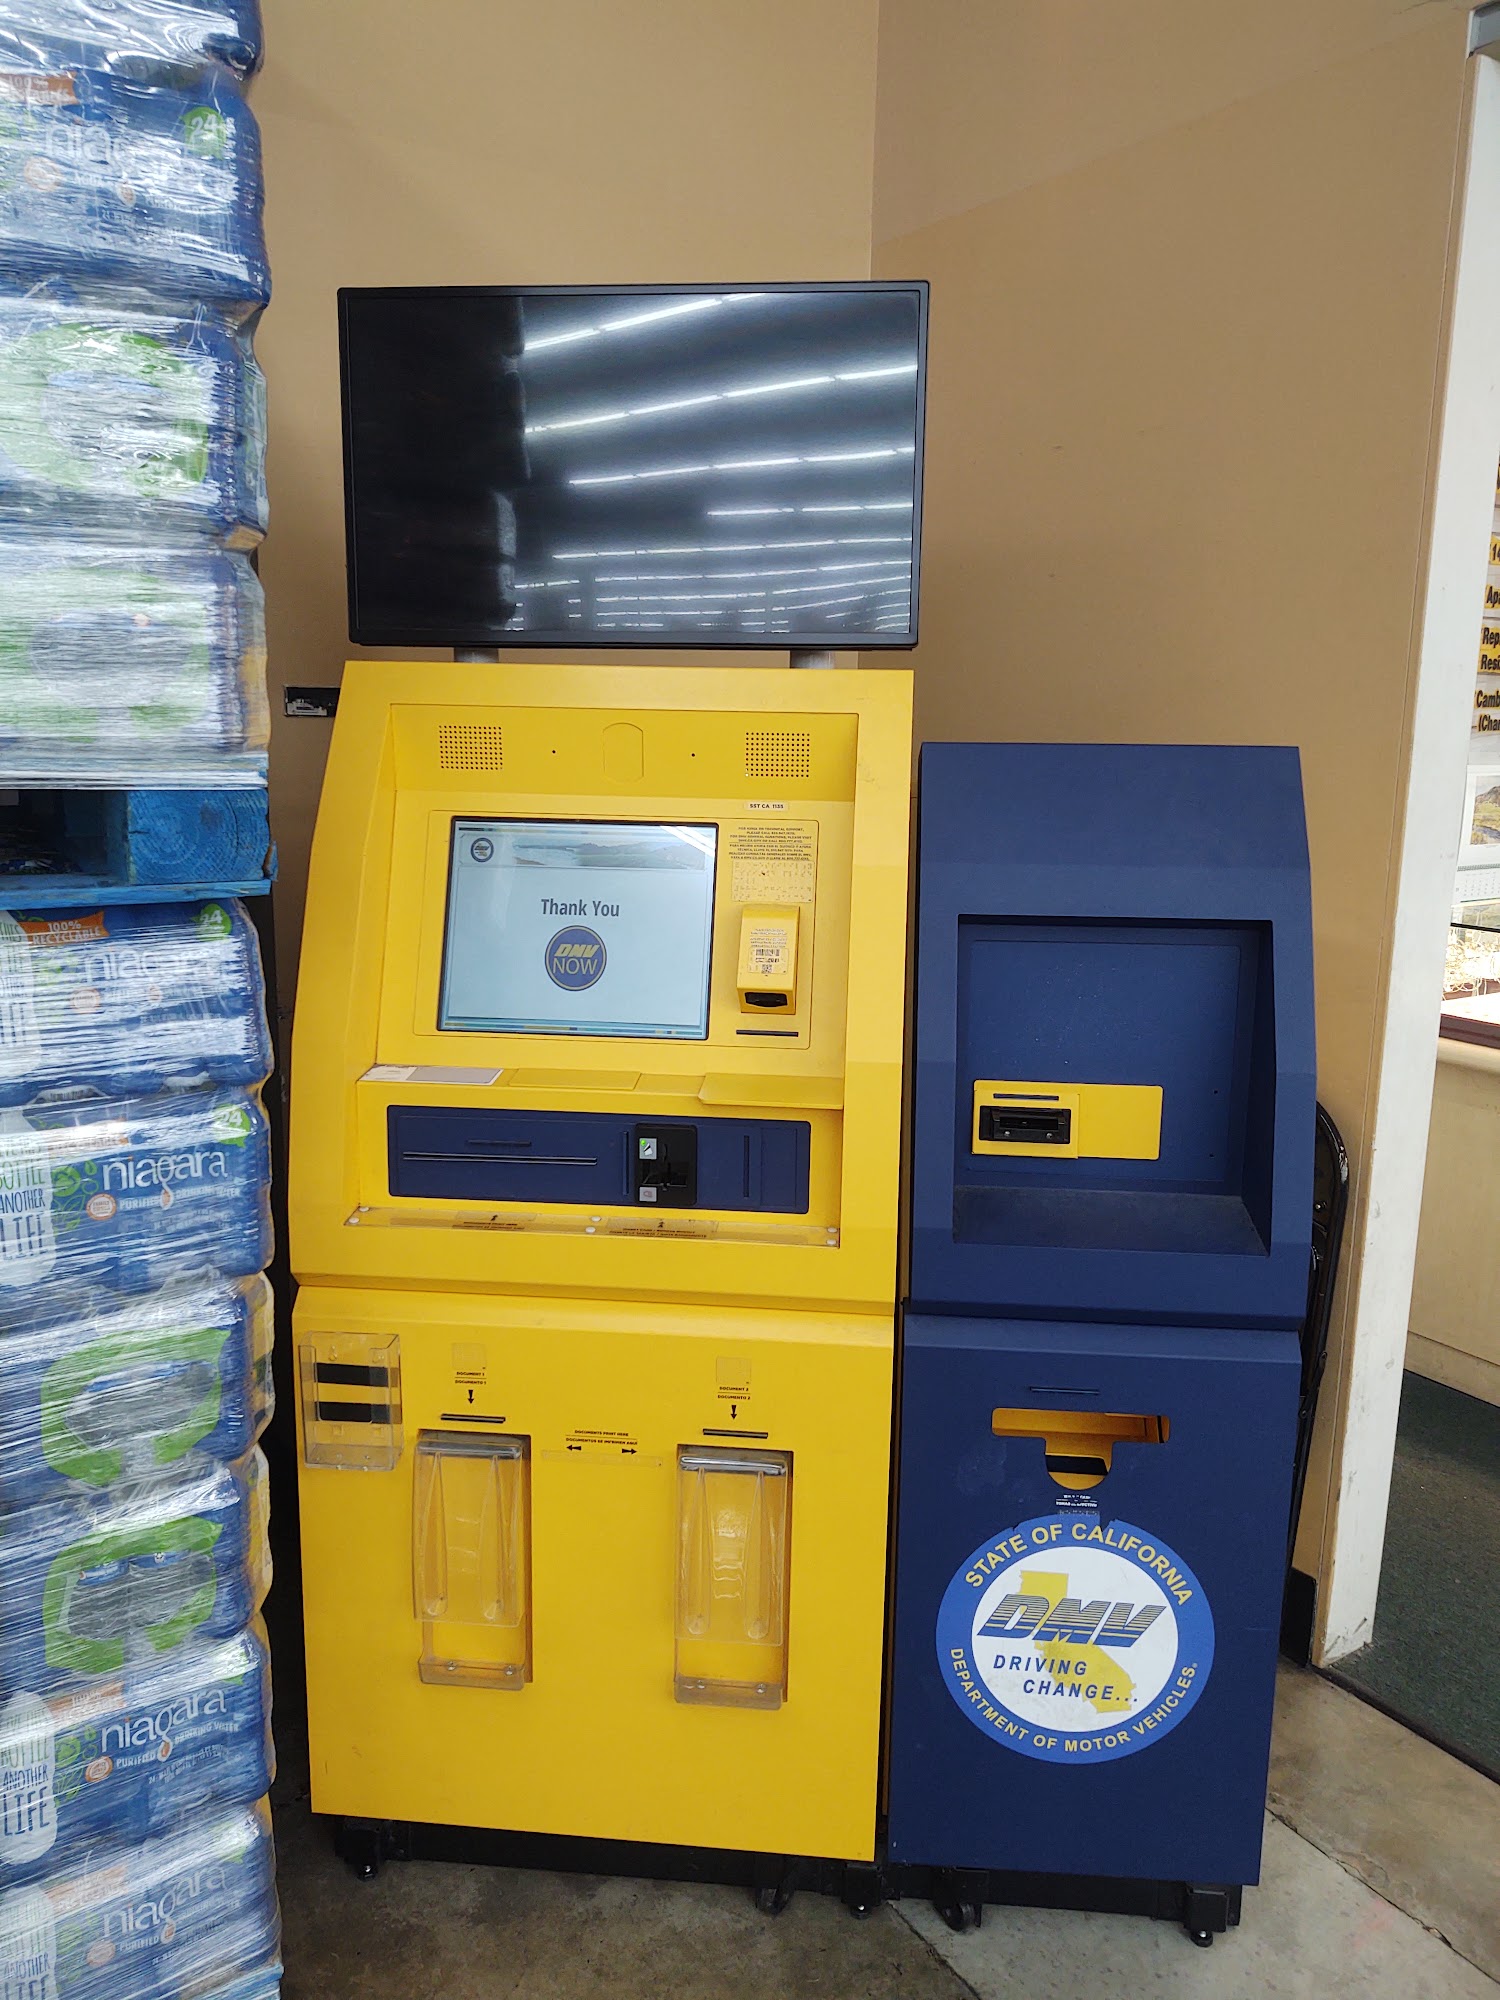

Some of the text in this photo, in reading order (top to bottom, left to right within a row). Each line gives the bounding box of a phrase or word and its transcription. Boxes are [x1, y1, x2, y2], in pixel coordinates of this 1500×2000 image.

[541, 898, 620, 917] Thank You
[32, 926, 100, 945] RECYCLABLE
[47, 920, 82, 932] 100%
[554, 943, 600, 958] DMV
[552, 957, 598, 975] NOW
[0, 1158, 45, 1191] OTTLE
[103, 1151, 228, 1209] niagara
[965, 1523, 1193, 1606] STATE OF CALIFORNIA
[977, 1593, 1167, 1648] DMV
[993, 1654, 1088, 1676] DRIVING
[950, 1648, 1029, 1740] DEPARTMENT
[1033, 1734, 1057, 1751] OF
[1064, 1730, 1131, 1752] MOTOR
[1023, 1679, 1138, 1702] CHANGE...
[102, 1689, 228, 1762] niagara
[116, 1752, 157, 1767] PURIFIED
[3, 1786, 50, 1836] LIFE
[103, 1866, 228, 1944] niagara
